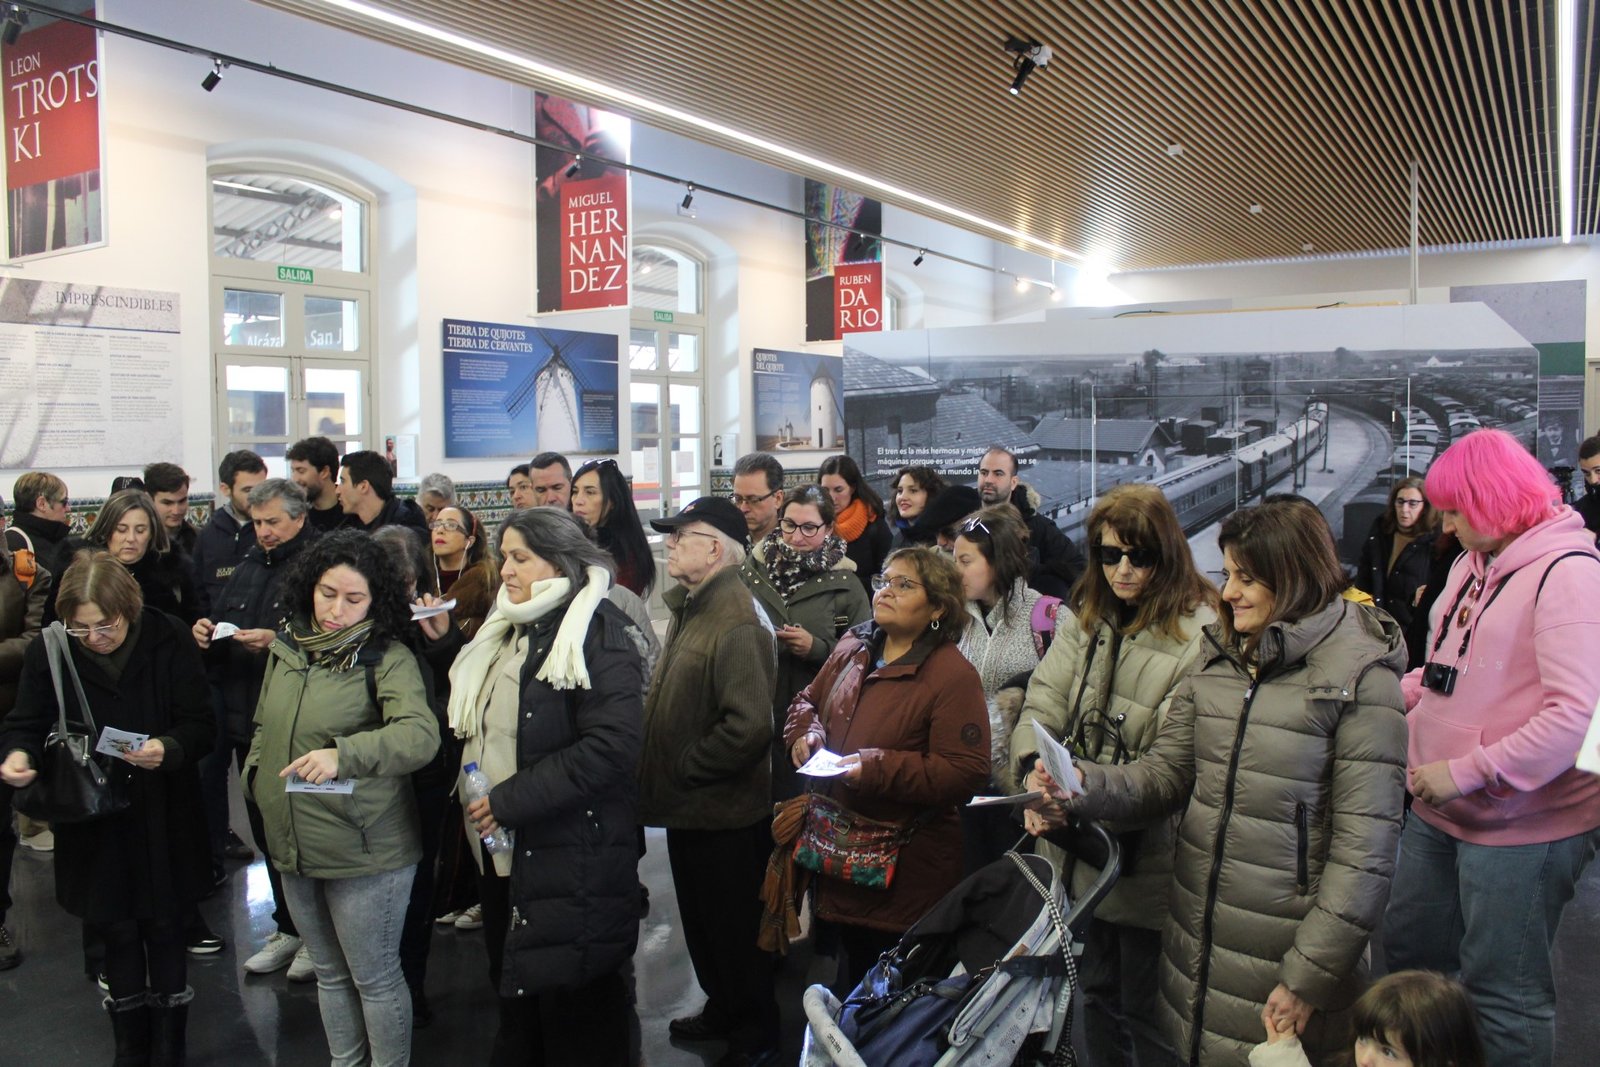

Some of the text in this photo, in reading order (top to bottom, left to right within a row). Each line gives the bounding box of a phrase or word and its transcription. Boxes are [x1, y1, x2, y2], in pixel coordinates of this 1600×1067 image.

[10, 52, 41, 77] LEON
[11, 59, 98, 119] TROTS
[13, 121, 42, 163] KI
[568, 191, 613, 209] MIGUEL
[568, 208, 624, 237] HER
[569, 234, 627, 266] NAN
[279, 268, 311, 281] SALIDA
[569, 265, 622, 294] DEZ
[839, 274, 871, 285] RUBEN
[55, 290, 173, 312] IMPRESCINDIBLES
[839, 287, 869, 307] DA
[655, 312, 672, 321] SALIDA
[310, 329, 333, 346] San
[447, 324, 526, 341] TIERRA DE QUIJOTES
[447, 336, 533, 353] TIERRA DE CERVANTES
[877, 447, 884, 455] El
[908, 447, 915, 455] la
[915, 447, 930, 455] más
[930, 446, 960, 454] hermosa
[961, 448, 966, 456] y
[1014, 446, 1025, 454] las
[877, 457, 909, 466] máquinas
[910, 458, 935, 467] porque
[954, 457, 979, 465] mundo
[947, 467, 971, 475] mundo
